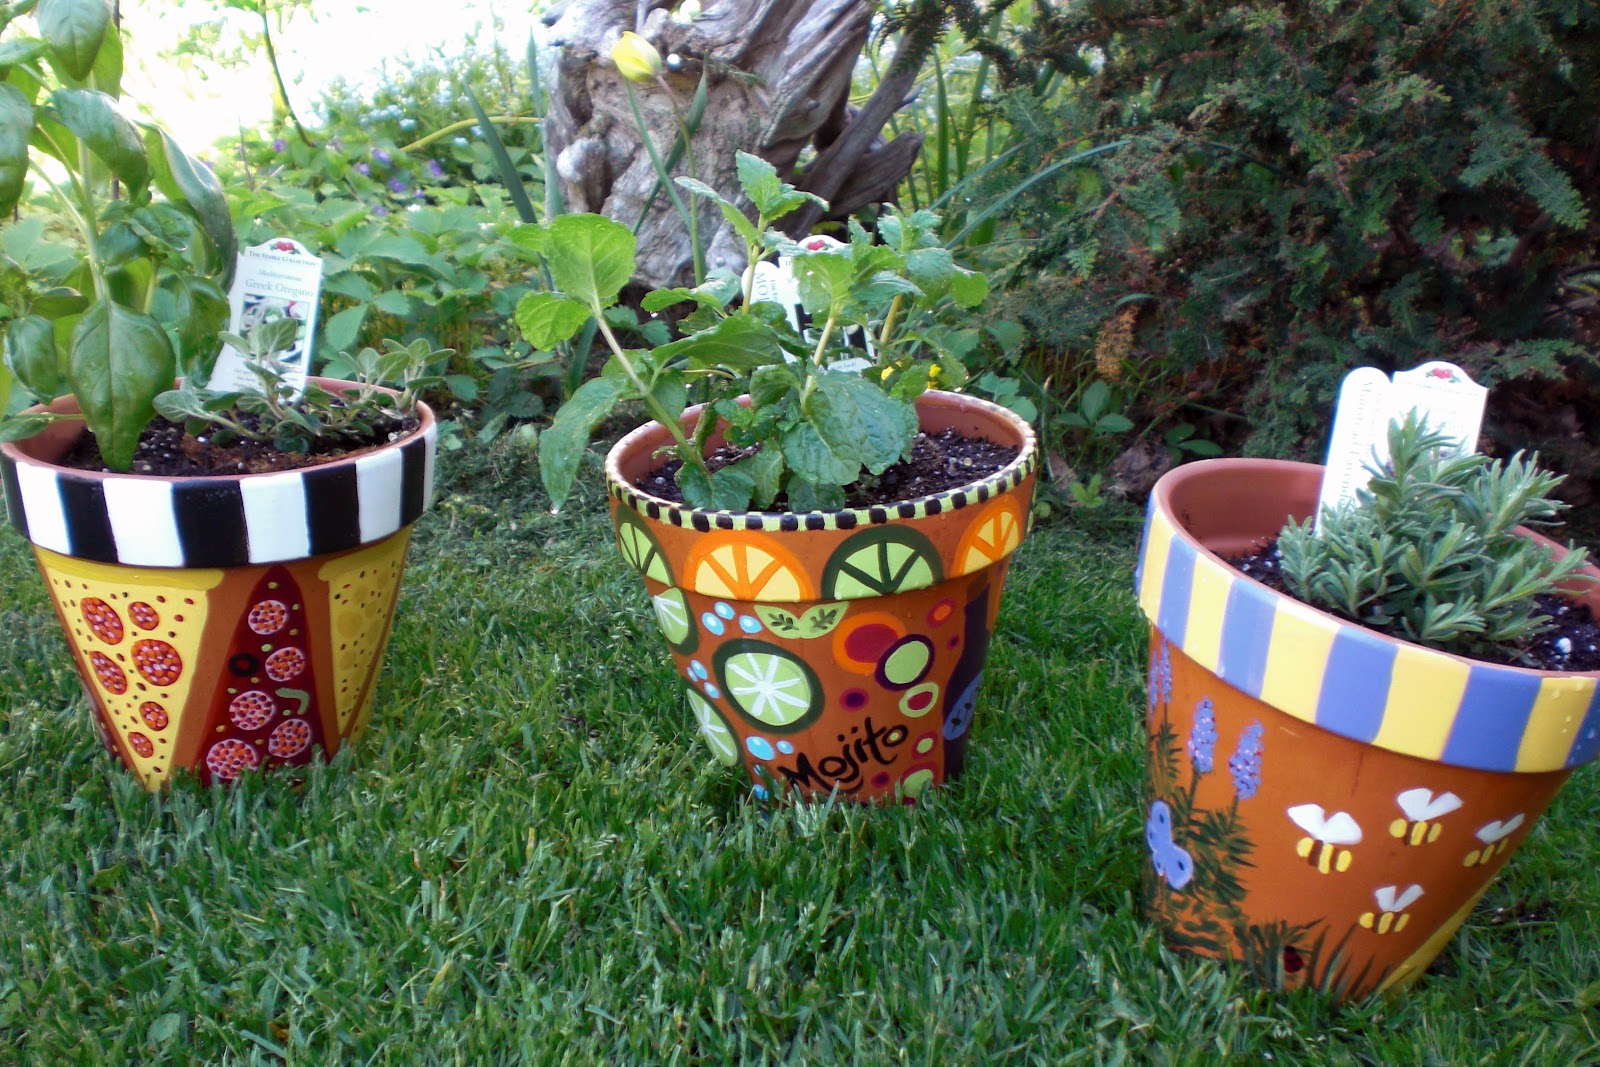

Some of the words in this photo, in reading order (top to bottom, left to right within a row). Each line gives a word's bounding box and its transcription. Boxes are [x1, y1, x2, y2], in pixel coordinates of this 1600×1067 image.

[245, 278, 273, 291] Greek
[275, 282, 314, 298] Oregano
[777, 716, 909, 796] Mojito
